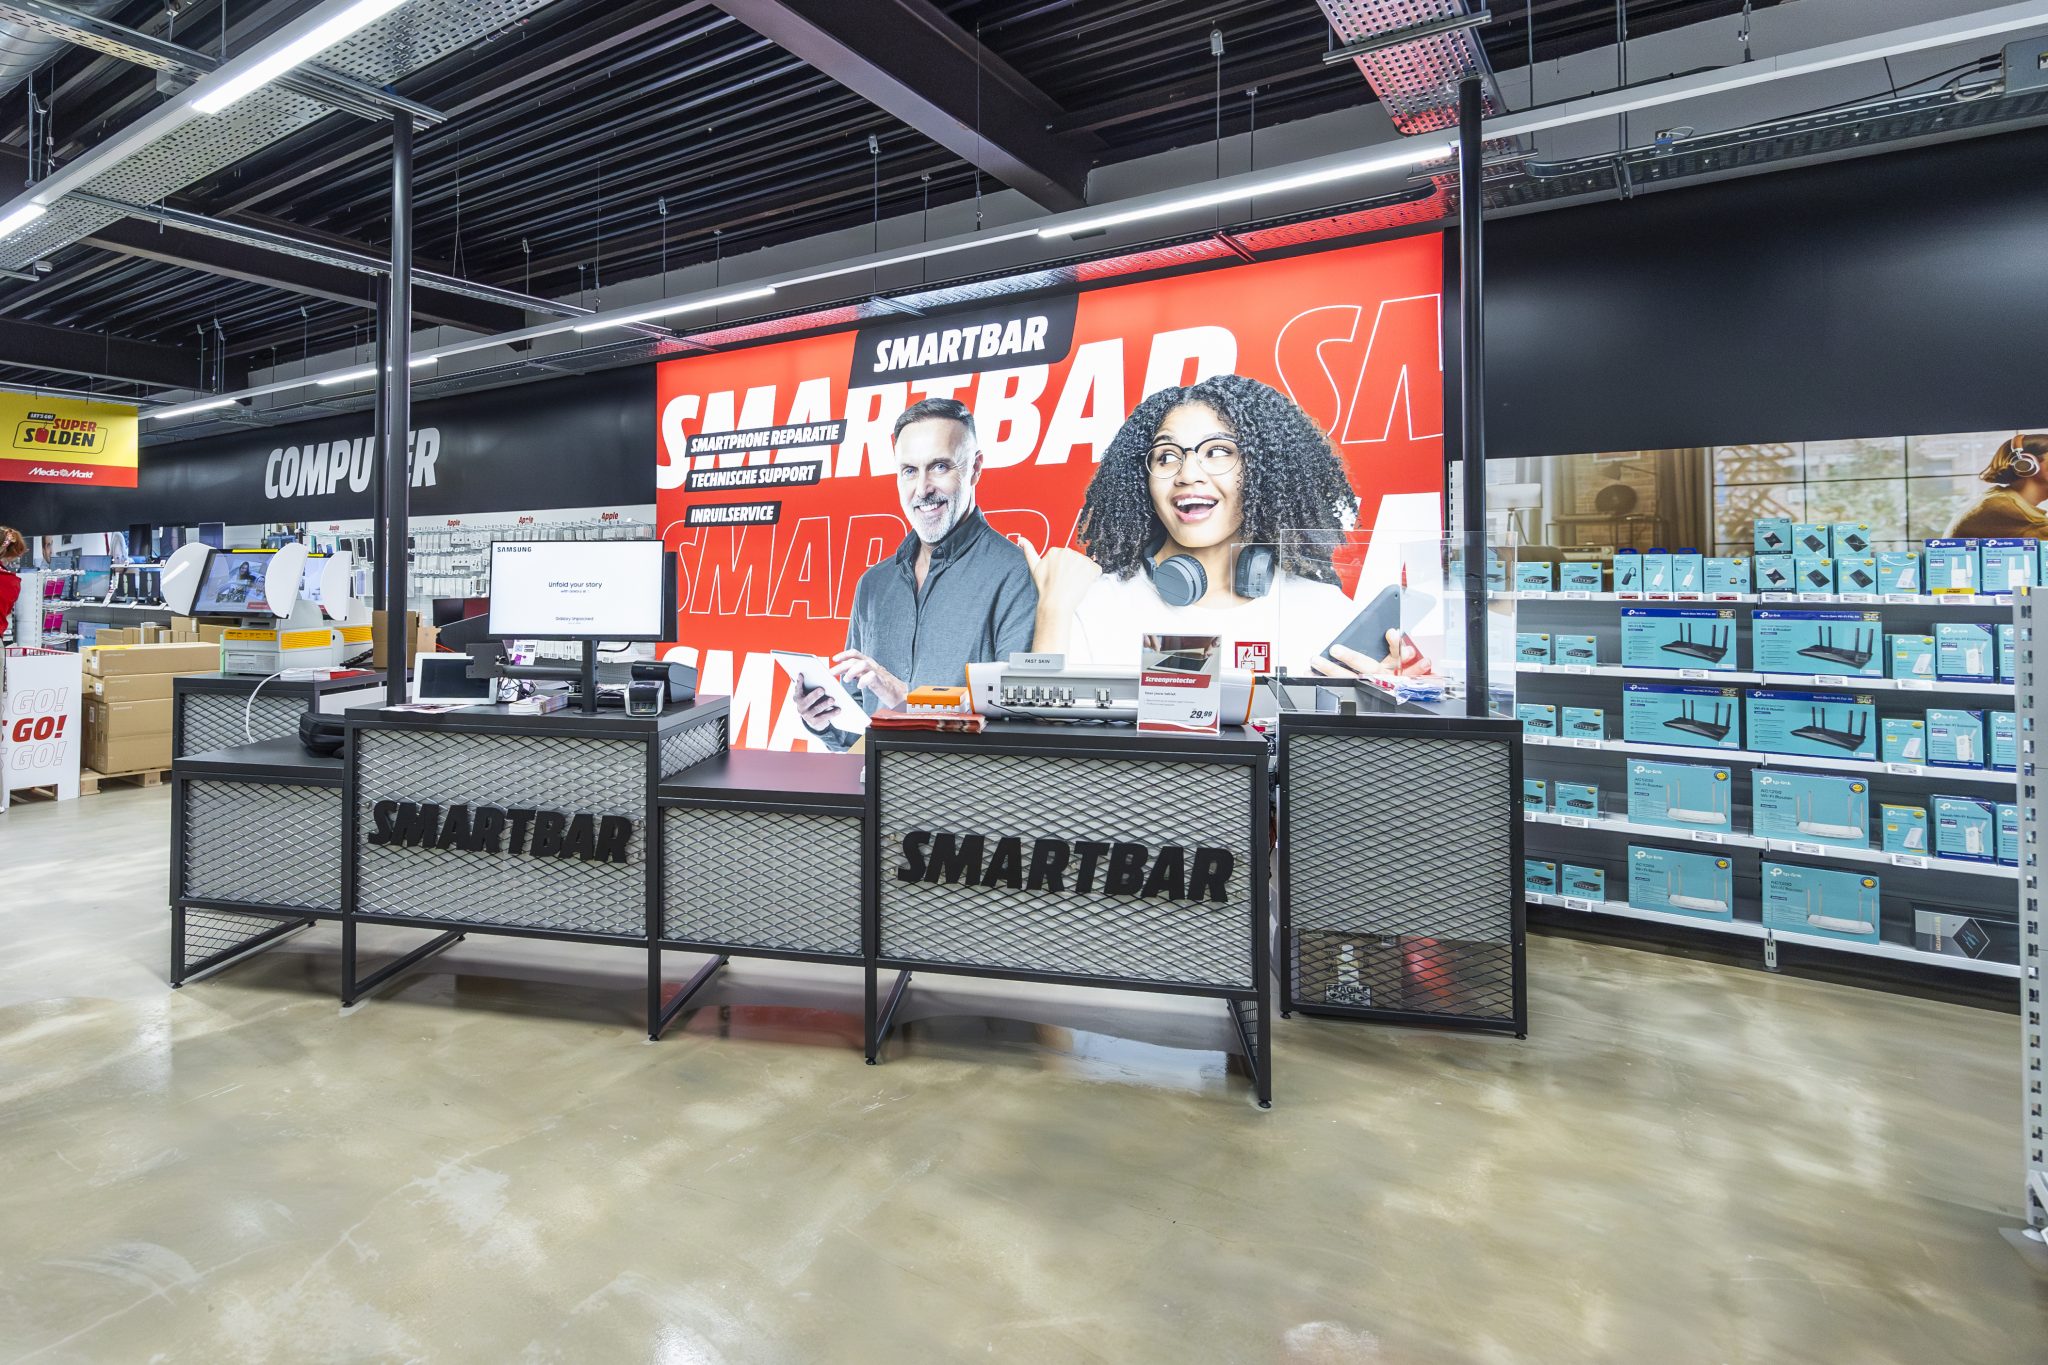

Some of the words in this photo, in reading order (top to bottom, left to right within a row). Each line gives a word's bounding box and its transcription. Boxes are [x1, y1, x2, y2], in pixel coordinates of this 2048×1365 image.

[873, 315, 1049, 373] SMARTBAR
[656, 325, 1238, 491] SMARBA
[53, 418, 97, 433] SUPER
[690, 430, 771, 453] SMARTPHONE
[770, 424, 840, 446] REPARATIE
[265, 427, 441, 500] COMPUR
[691, 469, 759, 488] TECHNISCHE
[758, 465, 817, 484] SUPPORT
[447, 519, 461, 528] Apple
[601, 511, 620, 522] Apple
[690, 505, 775, 524] INRUILSERVICE
[1145, 676, 1197, 685] Screenprotector
[12, 687, 68, 715] GO!
[1190, 710, 1213, 719] 29.99
[12, 714, 67, 742] GO!
[11, 741, 67, 770] GO!
[368, 800, 633, 864] SMARTBAR
[896, 830, 1236, 903] SMARTBAR
